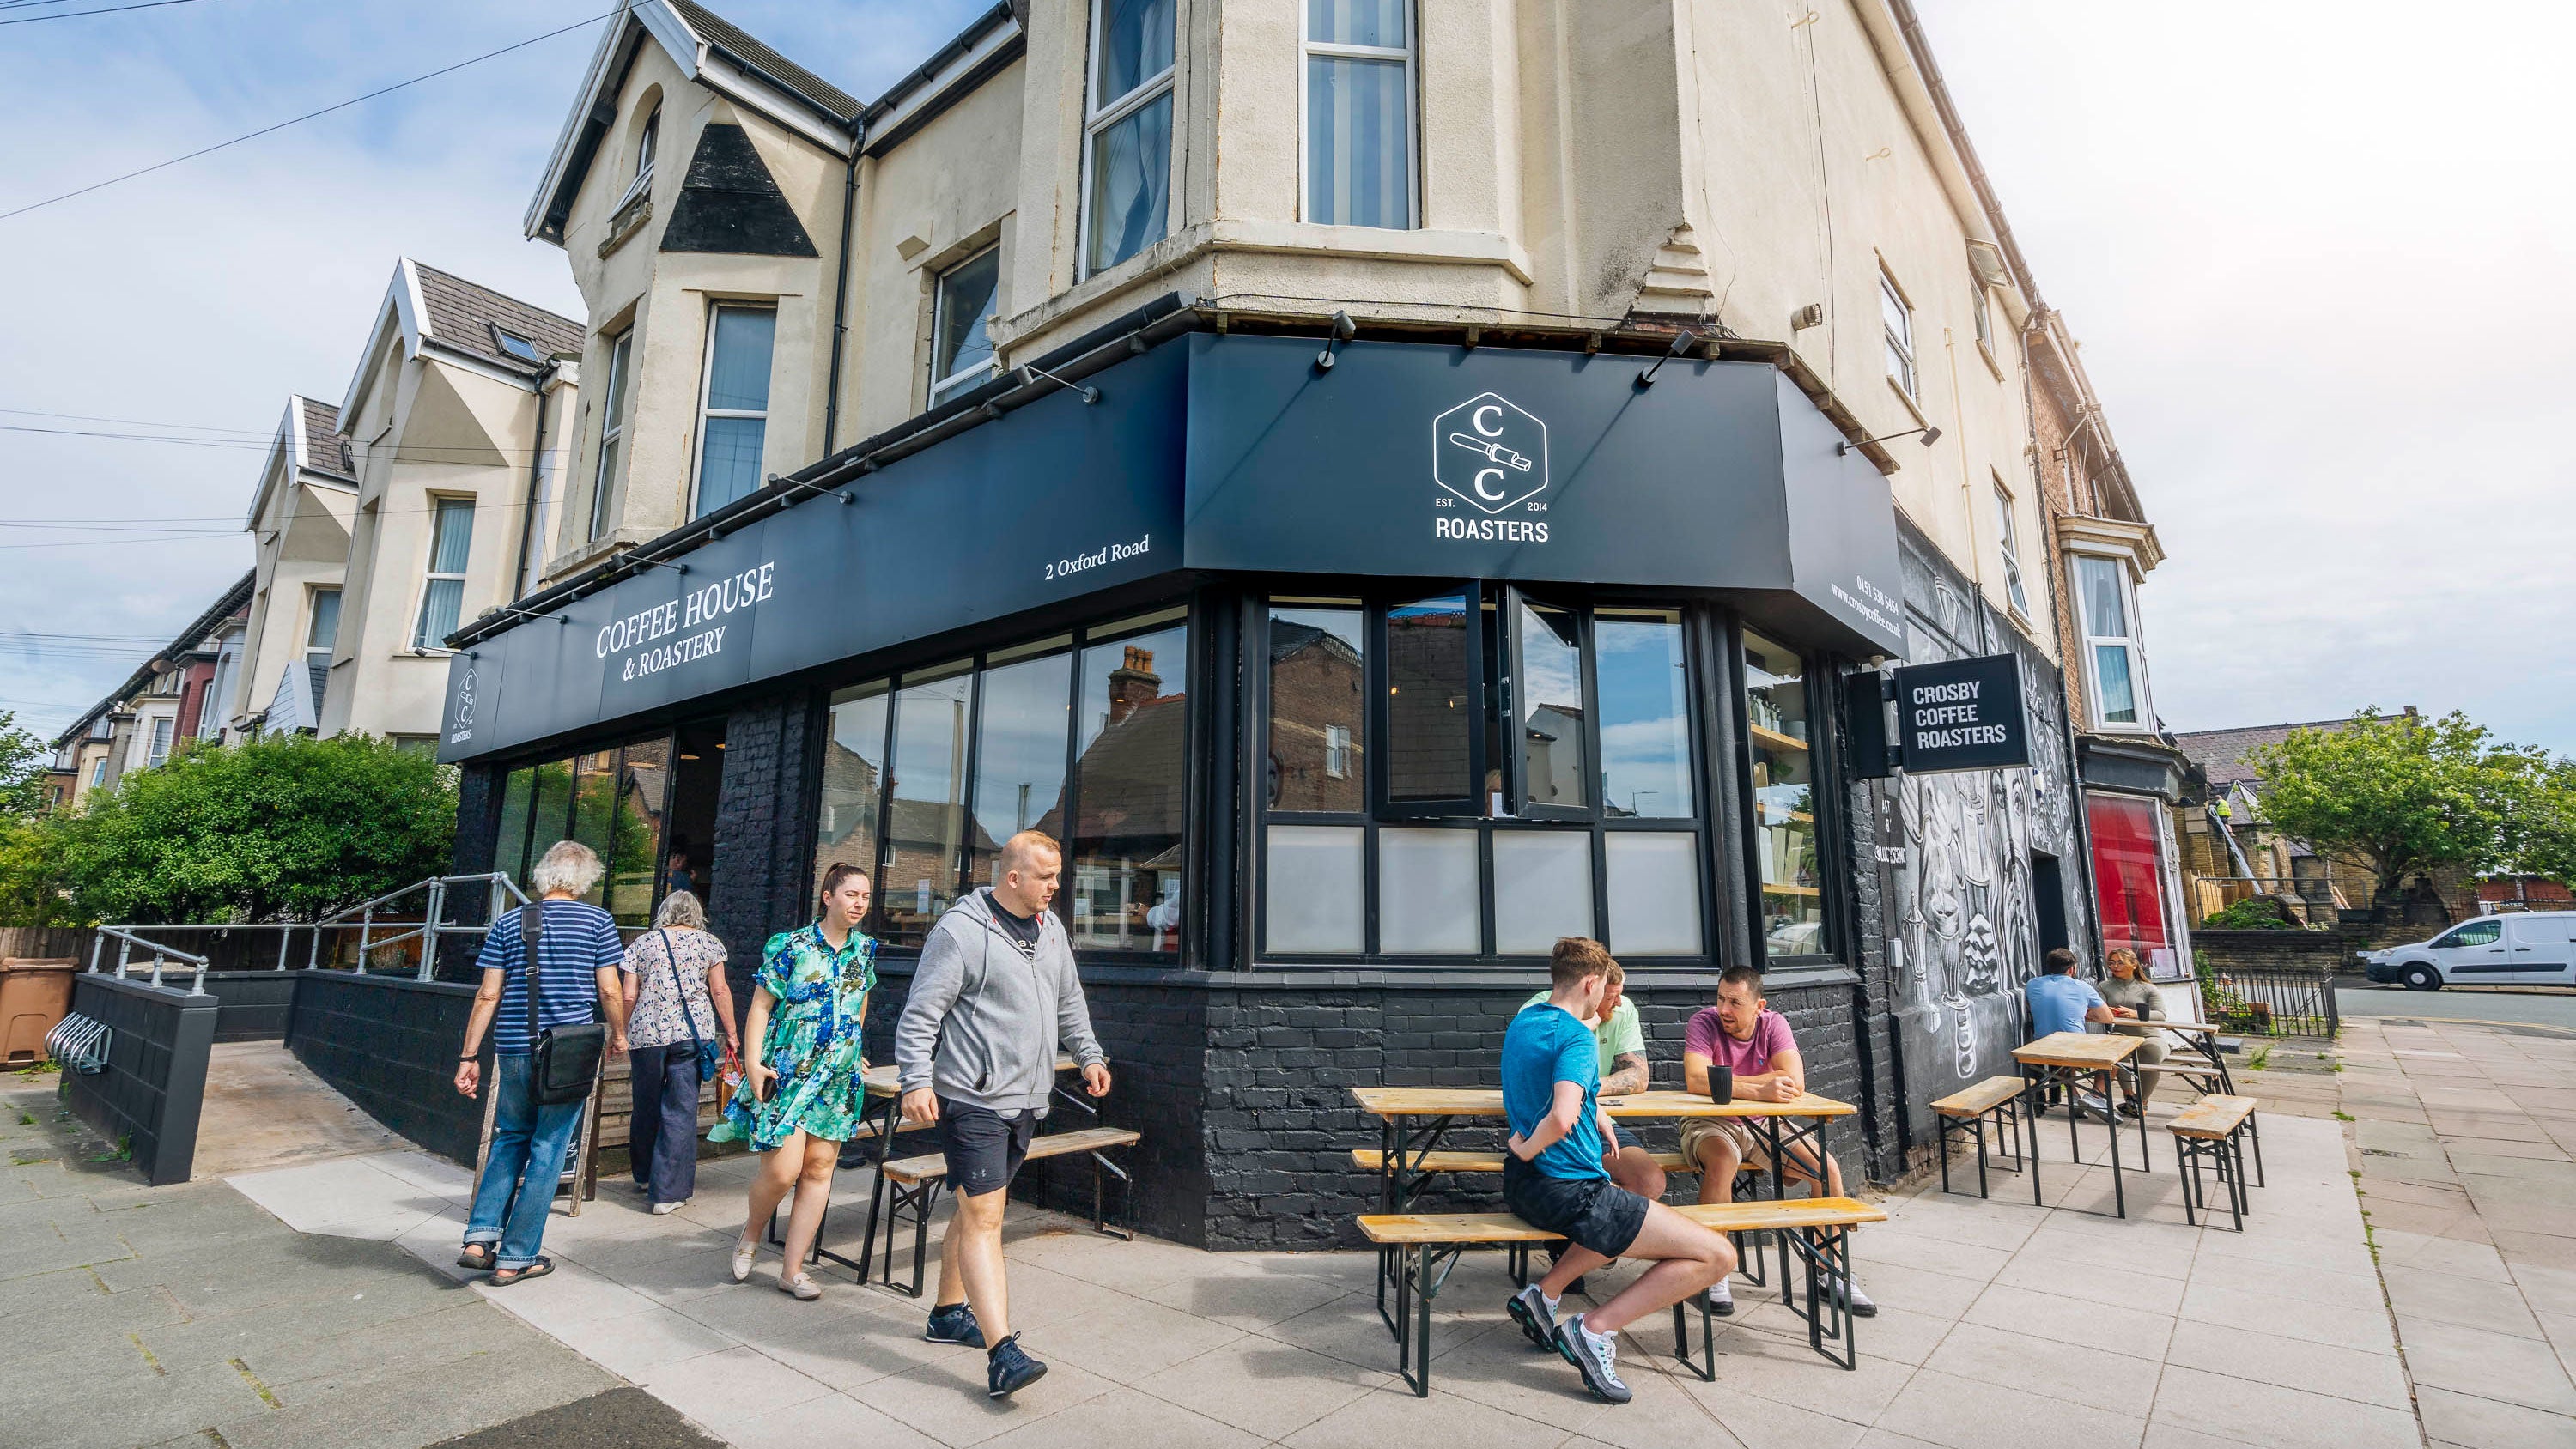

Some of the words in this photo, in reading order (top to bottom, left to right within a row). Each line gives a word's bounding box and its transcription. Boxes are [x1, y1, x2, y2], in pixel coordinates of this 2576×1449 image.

[1473, 405, 1504, 437] C
[1474, 468, 1504, 500] C
[1436, 498, 1455, 507] EST.
[1528, 502, 1547, 512] 2014
[1436, 518, 1549, 543] ROASTERS
[1044, 563, 1054, 580] 2
[1057, 547, 1106, 576] Oxford
[1110, 534, 1150, 561] Road
[1856, 575, 1872, 598] 0151
[596, 599, 678, 658] COFFEE
[683, 561, 775, 628] HOUSE
[1831, 582, 1902, 639] www.crosbycoffee.co.uk
[623, 658, 635, 682] &
[638, 626, 726, 676] ROASTERY
[465, 675, 473, 690] C
[1912, 681, 1980, 705] CROSBY
[461, 706, 468, 722] C
[1915, 704, 1978, 727] COFFEE
[1917, 724, 2007, 749] ROASTERS
